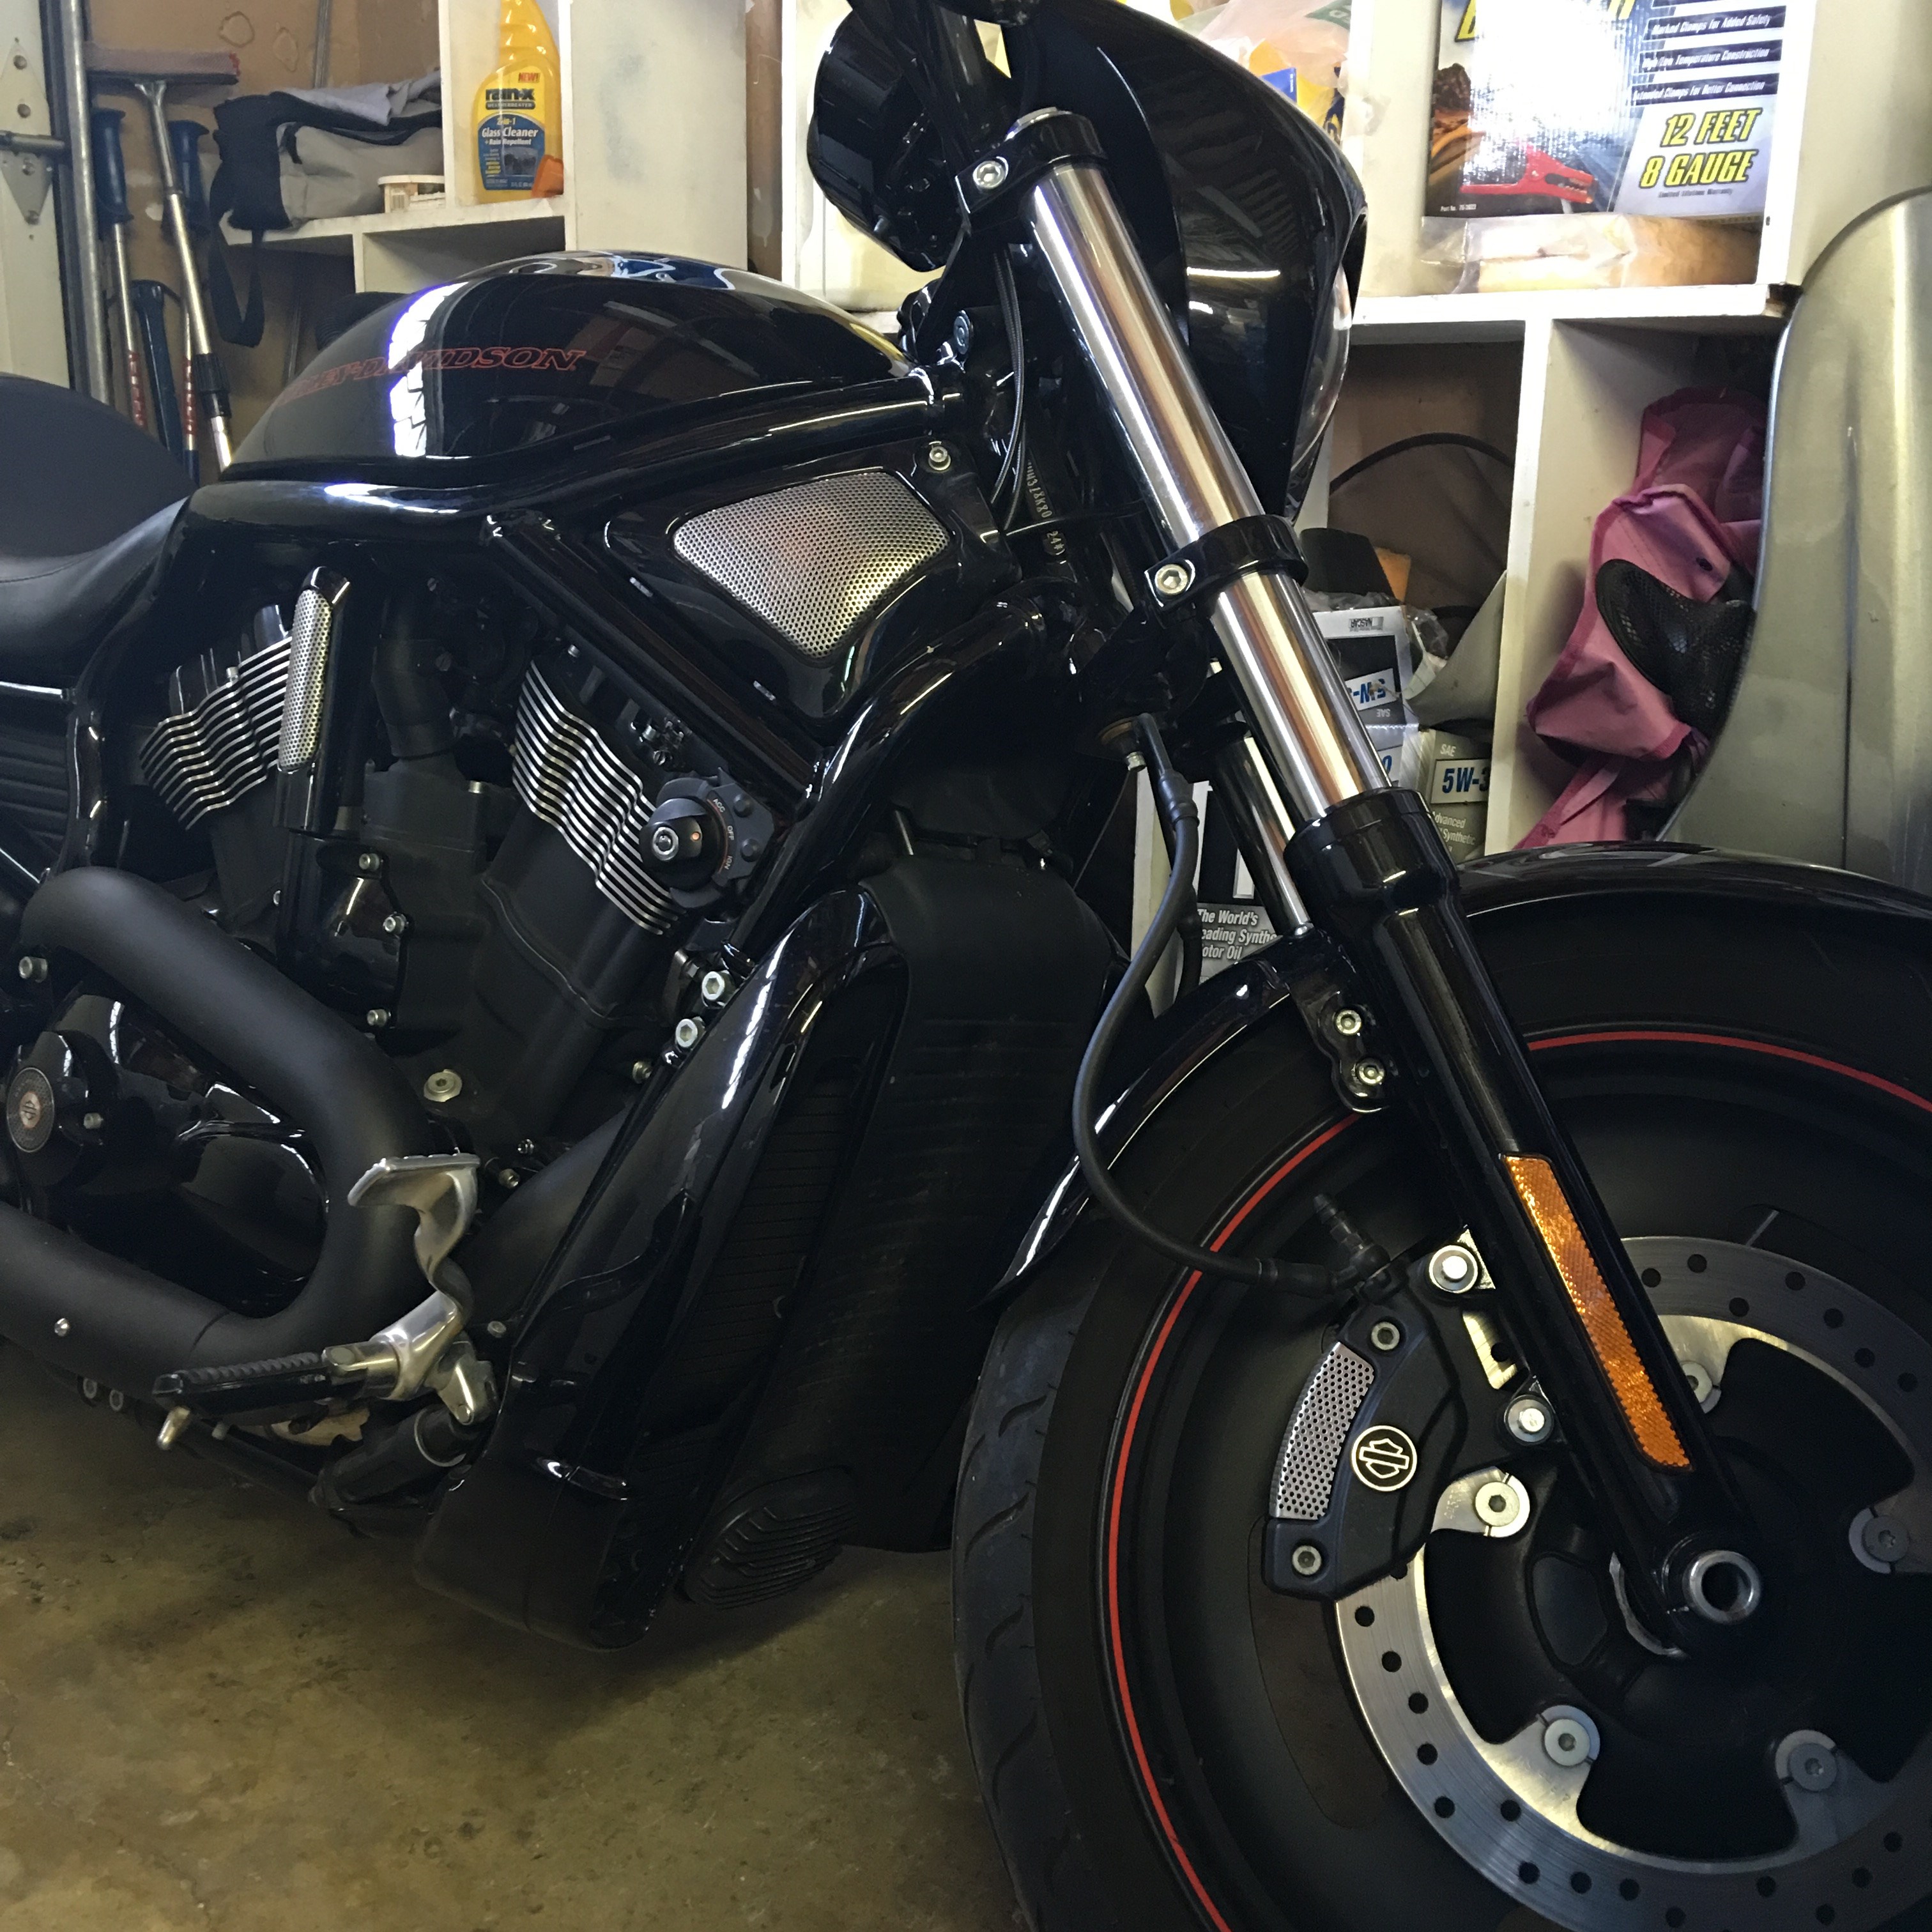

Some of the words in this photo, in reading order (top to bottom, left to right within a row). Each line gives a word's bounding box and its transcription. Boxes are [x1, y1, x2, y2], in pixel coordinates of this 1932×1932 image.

[1721, 16, 1746, 28] Added
[1746, 14, 1772, 27] Safety
[1675, 53, 1721, 66] Temperature
[1721, 48, 1770, 61] Construction
[1725, 81, 1765, 93] Connection
[482, 126, 500, 137] Glass
[502, 126, 539, 137] Cleaner
[1660, 112, 1696, 148] 12
[1694, 107, 1763, 145] FEET
[1639, 155, 1666, 188] 8
[1664, 149, 1759, 188] GAUGE
[1377, 709, 1390, 717] SAE
[1440, 744, 1457, 756] SAE
[1442, 767, 1491, 793] 5W-3
[713, 799, 725, 813] ACC
[1443, 829, 1476, 845] Synthetic
[724, 855, 733, 870] IGN
[1197, 908, 1215, 923] The
[1218, 910, 1259, 926] World's
[1202, 927, 1236, 945] eading
[1202, 945, 1225, 958] otor
[1227, 946, 1243, 960] Oil
